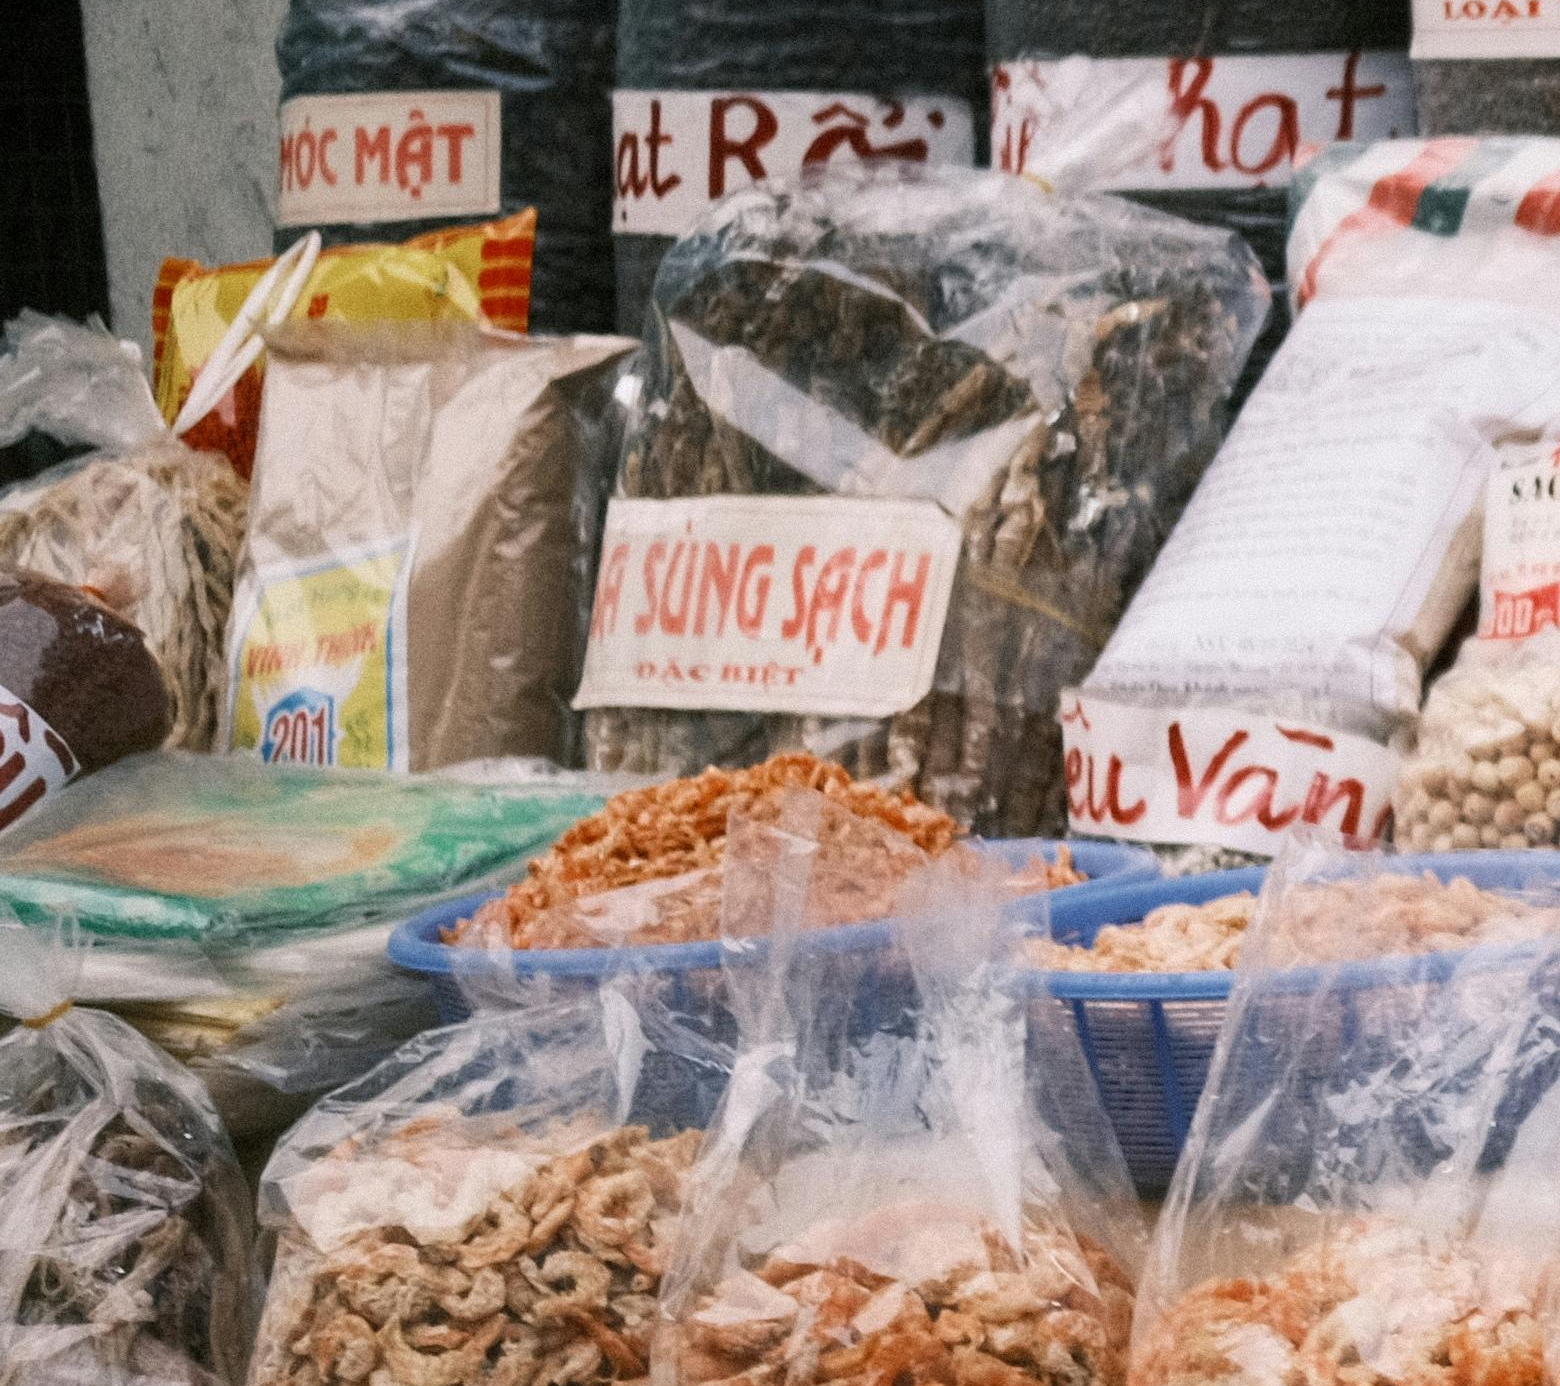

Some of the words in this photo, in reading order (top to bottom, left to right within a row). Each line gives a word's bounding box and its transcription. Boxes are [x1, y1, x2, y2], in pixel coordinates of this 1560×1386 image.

[353, 109, 476, 202] MẬT
[779, 543, 932, 667] SẠCH
[272, 706, 327, 766] 201
